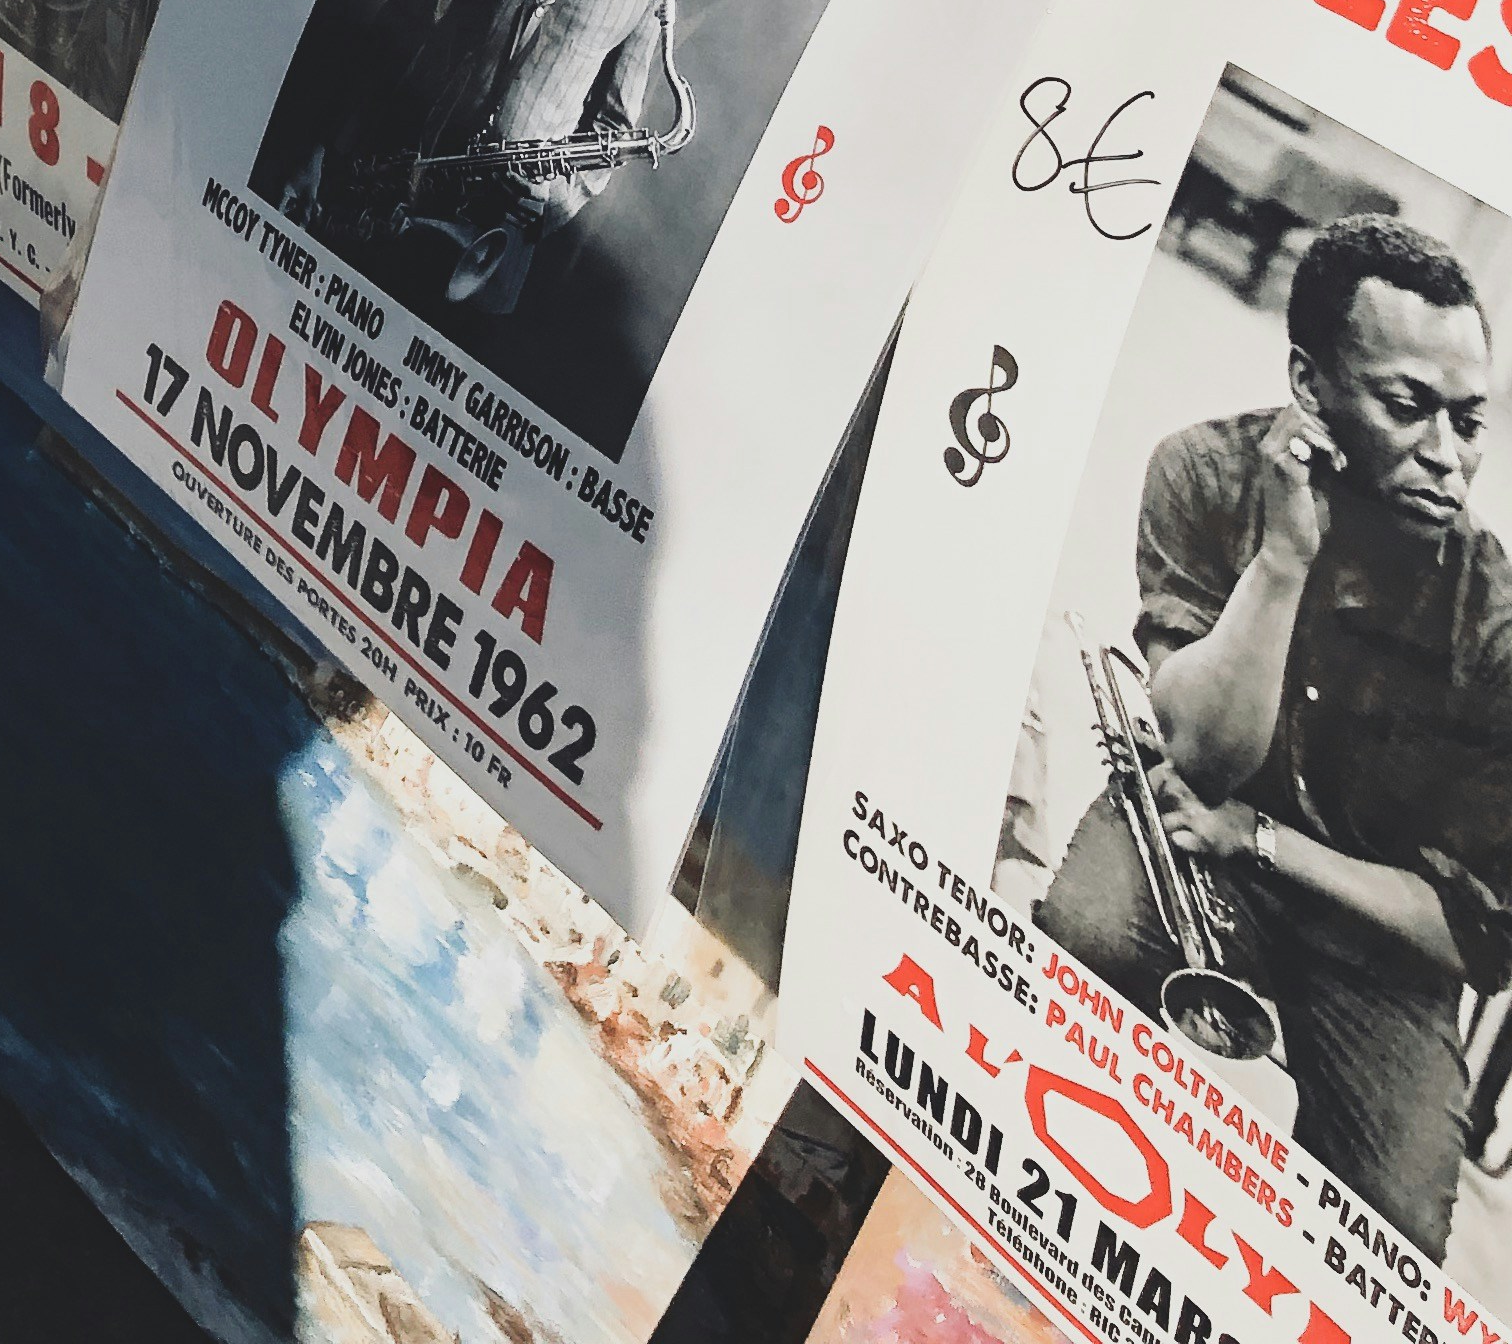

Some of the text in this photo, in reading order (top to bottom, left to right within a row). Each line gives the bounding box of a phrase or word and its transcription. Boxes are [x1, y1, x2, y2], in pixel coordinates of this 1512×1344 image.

[1011, 76, 1162, 240] 8€
[202, 177, 386, 342] MCCOY TYNER PIANO
[205, 299, 557, 648] OLYMPIA
[288, 299, 509, 494] ELVIN JONES BATTERIE
[142, 342, 598, 787] 17 NOVEMBRE 1962
[170, 460, 399, 684] OUVERTURE PORTES 20H
[843, 828, 1296, 1229] CONTREBASSE: CHAMBERS
[850, 790, 1291, 1175] SAXO TENOR: COLTRANE
[859, 1007, 1004, 1178] LUNDI
[987, 1206, 1080, 1306] Téléphone
[988, 1182, 1081, 1281] Boulevard
